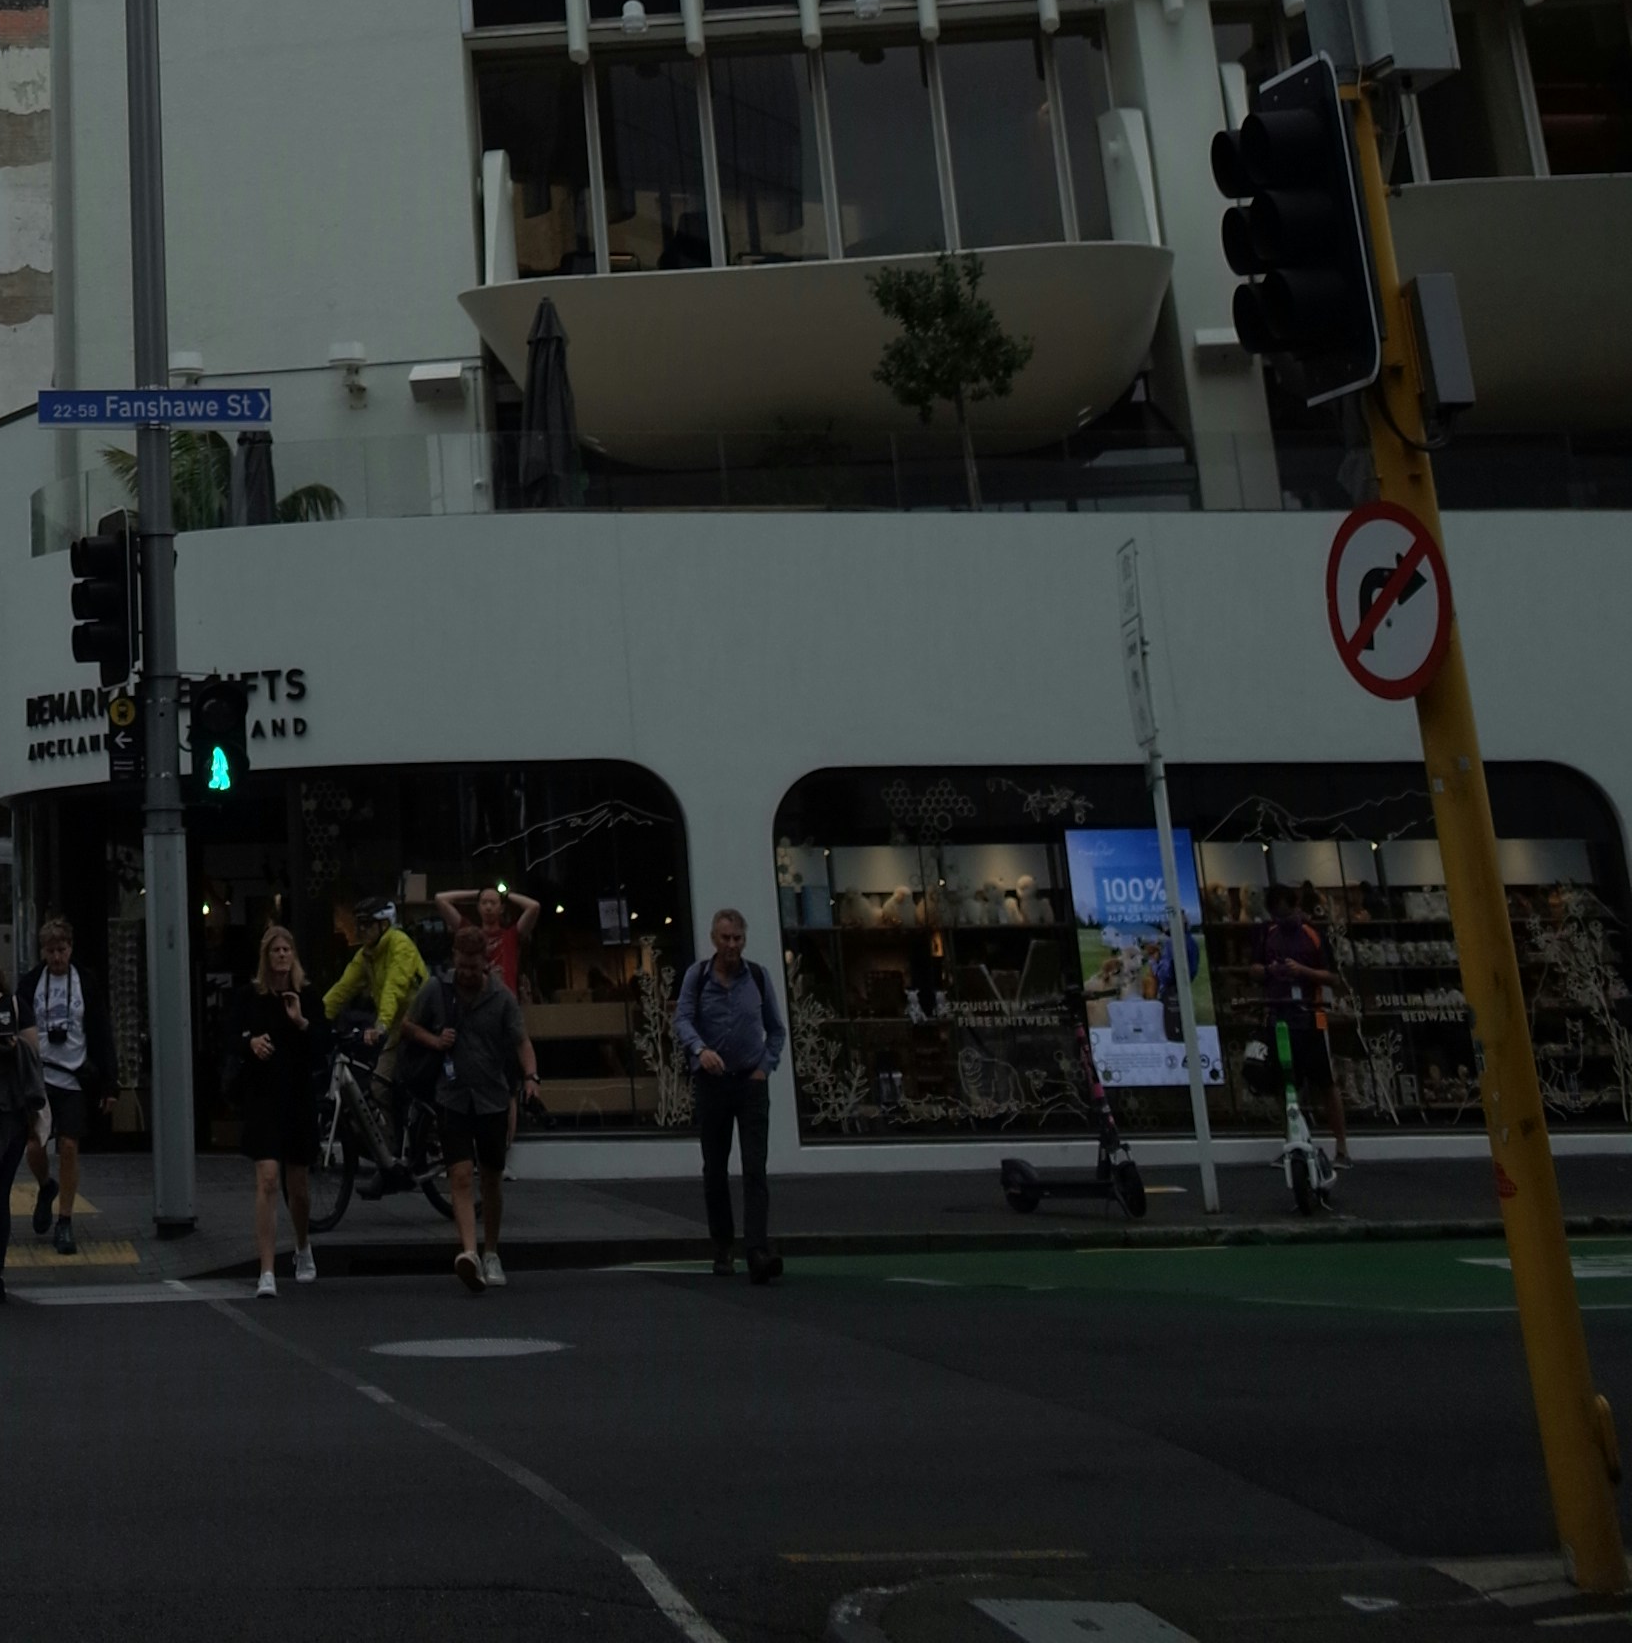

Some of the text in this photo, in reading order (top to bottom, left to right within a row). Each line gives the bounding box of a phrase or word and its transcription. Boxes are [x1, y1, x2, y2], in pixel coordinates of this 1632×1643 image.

[52, 394, 252, 419] 22-58 Fanshawe St
[1102, 877, 1166, 903] 100%
